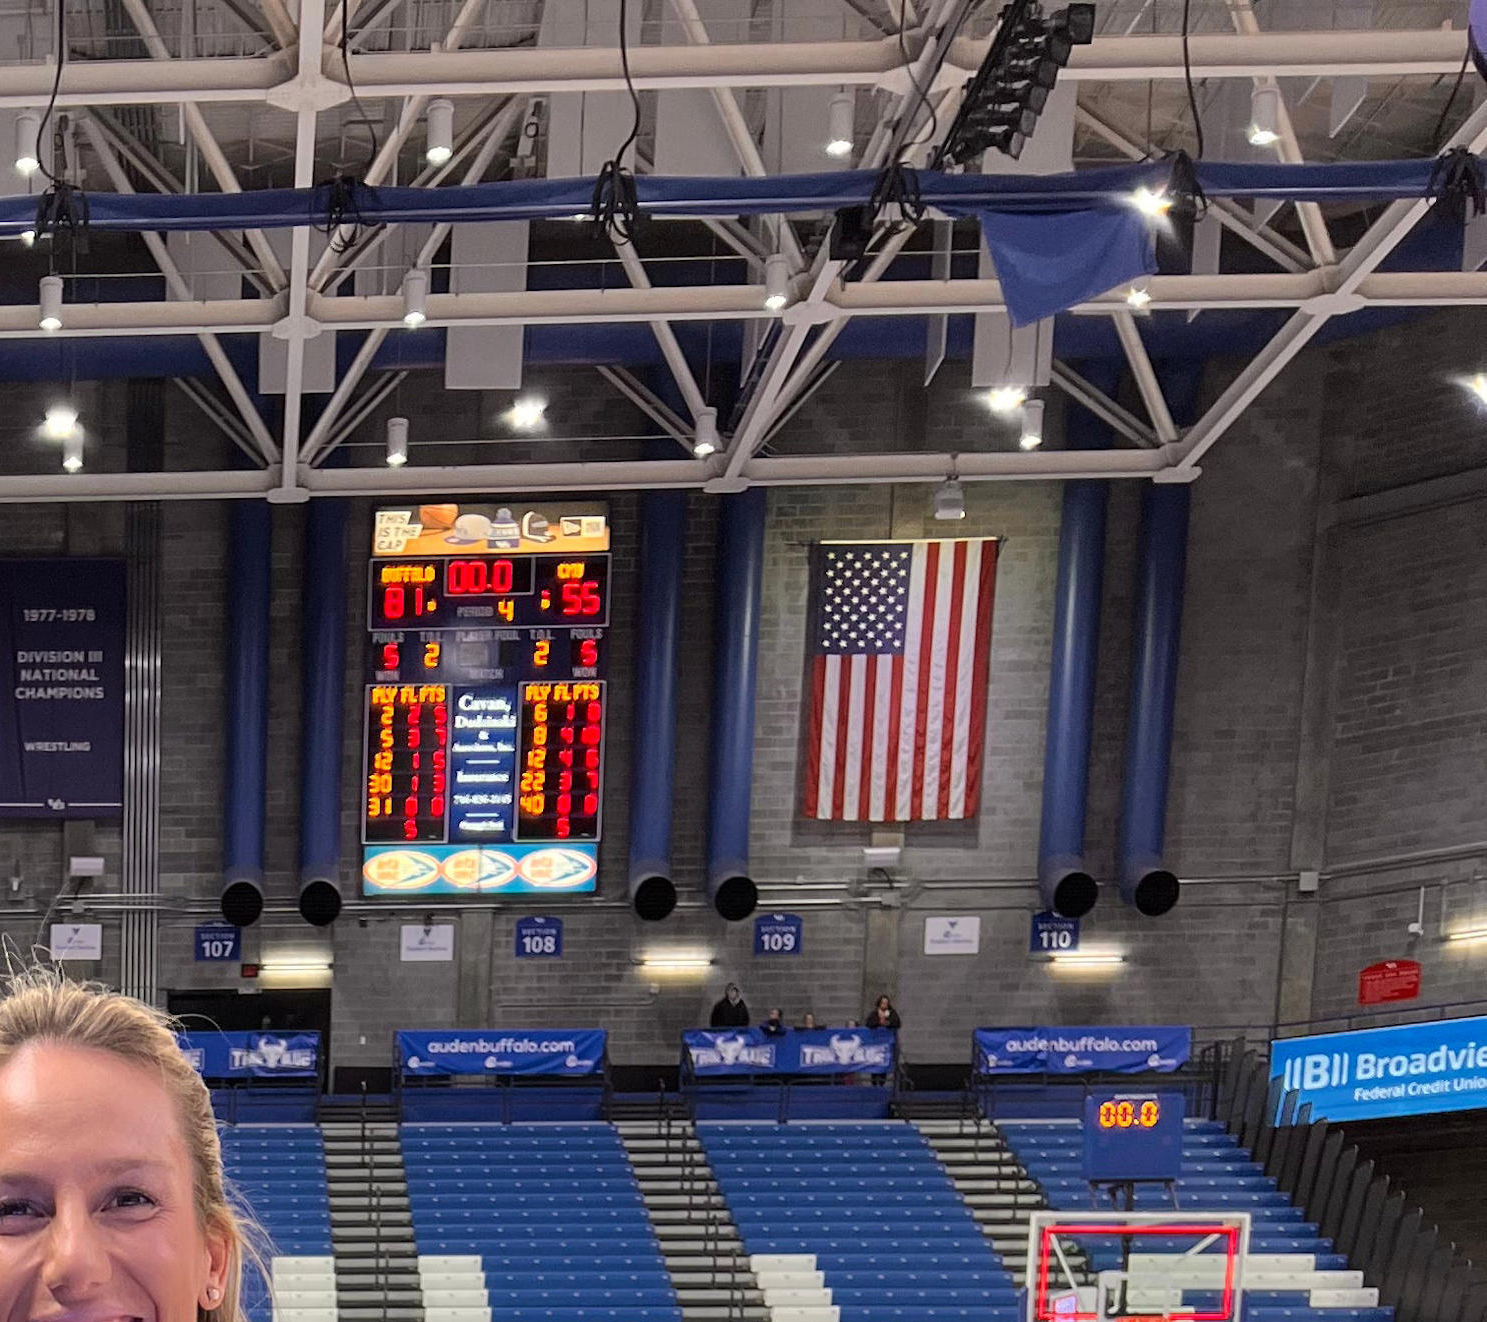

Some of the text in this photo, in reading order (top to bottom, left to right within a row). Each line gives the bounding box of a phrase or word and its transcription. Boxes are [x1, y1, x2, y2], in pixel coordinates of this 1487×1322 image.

[379, 513, 406, 524] THIS
[379, 526, 418, 538] IS THE
[381, 565, 436, 584] BUFFALO
[449, 560, 513, 593] 00.0
[384, 586, 423, 619] 81
[563, 582, 601, 615] 55
[23, 609, 96, 622] 1977-1978
[498, 599, 514, 622] 4
[372, 631, 405, 643] FOULS
[570, 628, 604, 640] FOULS
[17, 650, 103, 664] DIVISION III
[424, 641, 440, 668] 2
[533, 639, 550, 667] 2
[20, 669, 100, 682] NATIONAL
[15, 687, 104, 700] CHAMPIONS
[381, 704, 394, 726] 2
[534, 702, 548, 723] 6
[24, 742, 91, 752] WRESTLING
[520, 771, 546, 792] 22
[368, 796, 392, 817] 31
[523, 935, 555, 953] 108
[761, 933, 796, 951] 109
[1040, 931, 1071, 948] 110
[202, 941, 234, 957] 107
[428, 1037, 575, 1055] audenbuffalo.com
[1006, 1036, 1158, 1052] audenbuffalo.com
[1356, 1042, 1487, 1081] Broadvie
[1354, 1076, 1487, 1101] Federal Credit Unio
[1099, 1100, 1159, 1128] 00.0
